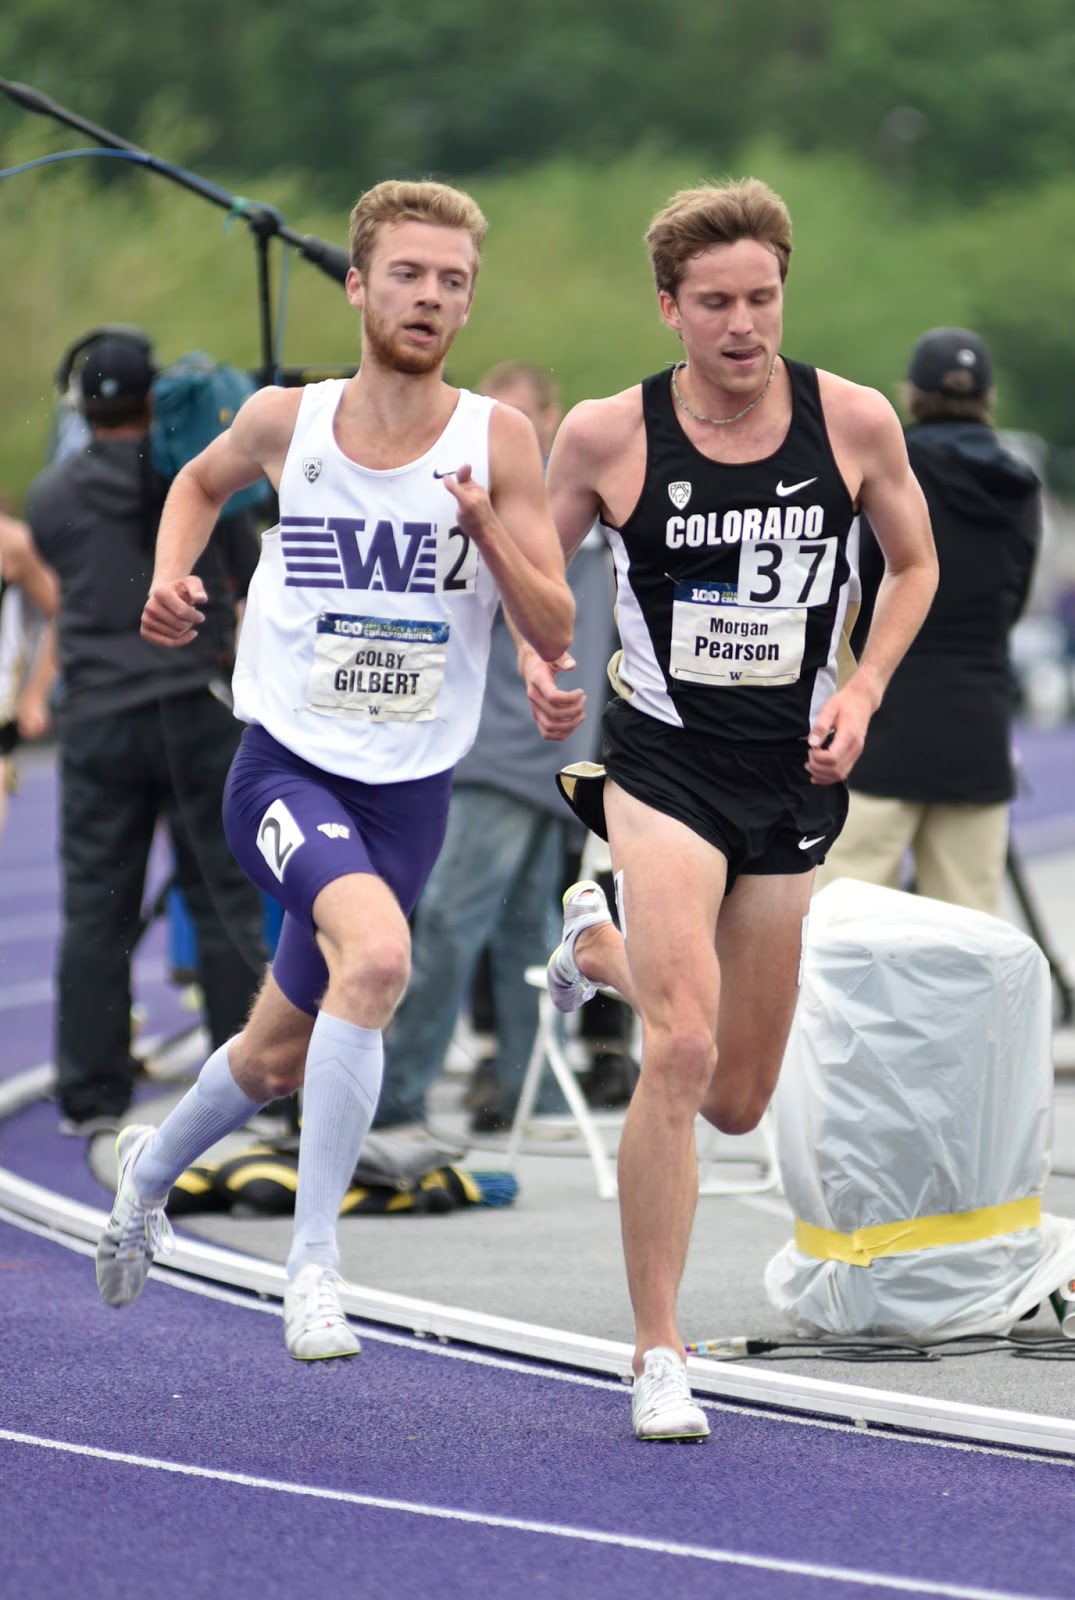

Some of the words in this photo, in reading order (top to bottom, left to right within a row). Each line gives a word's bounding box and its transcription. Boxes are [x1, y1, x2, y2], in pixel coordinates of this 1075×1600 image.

[670, 482, 690, 498] PAC
[675, 493, 686, 504] 12
[666, 505, 823, 548] COLORADO
[327, 517, 431, 593] W
[443, 525, 469, 591] 2
[750, 542, 828, 603] 37
[691, 588, 720, 602] 100
[334, 620, 362, 635] 100
[709, 617, 768, 637] Morgan
[694, 635, 779, 660] Pearson
[355, 650, 405, 670] COLBY
[334, 669, 420, 695] GILBERT
[729, 671, 743, 681] W
[367, 705, 380, 716] W
[261, 817, 293, 871] 2
